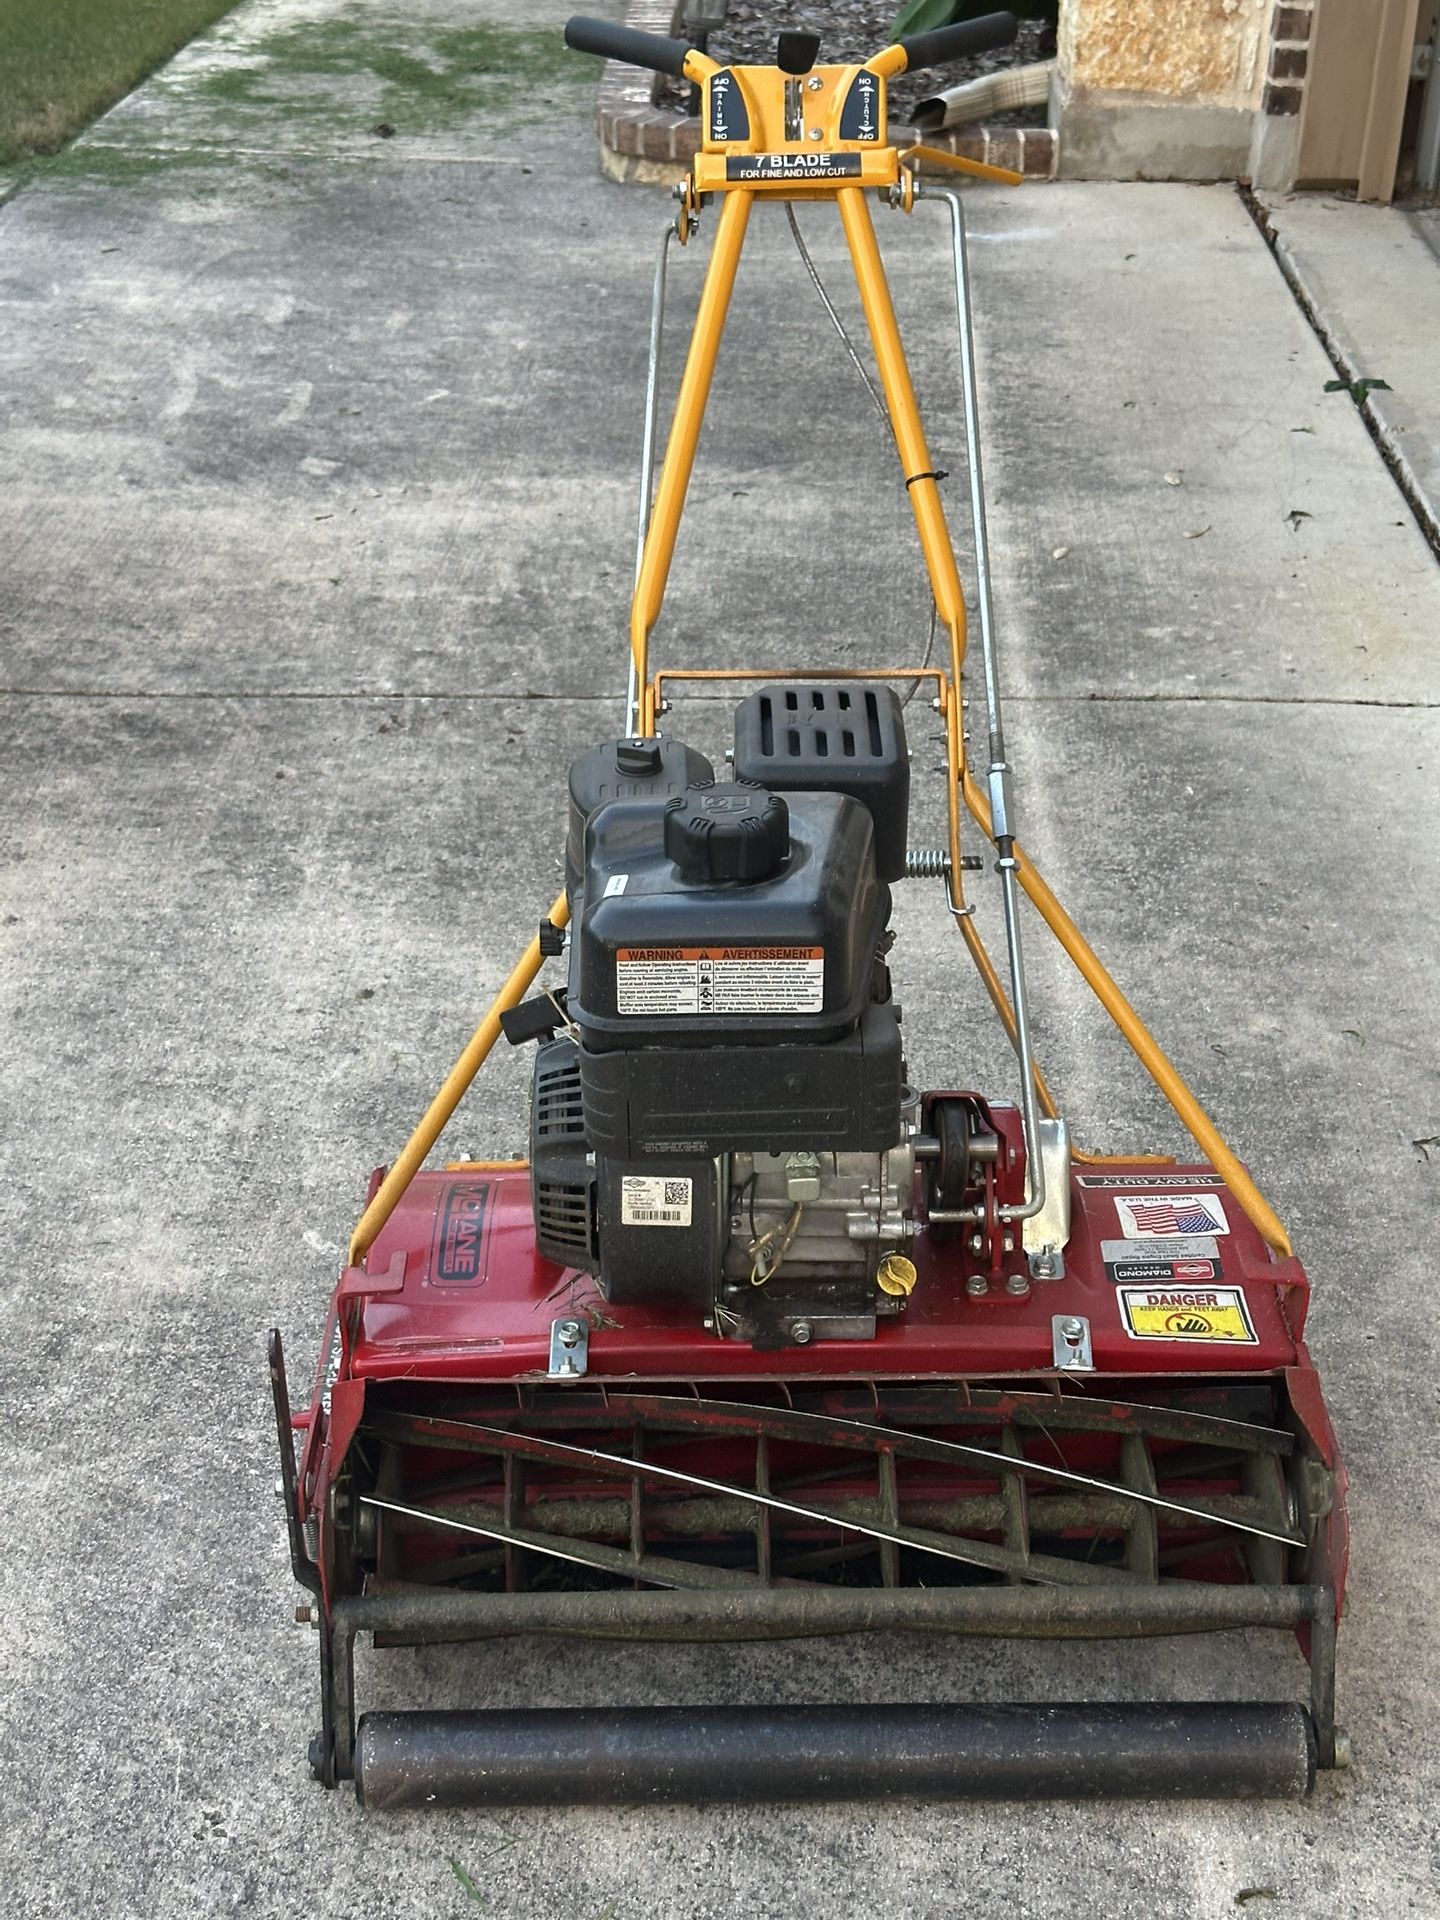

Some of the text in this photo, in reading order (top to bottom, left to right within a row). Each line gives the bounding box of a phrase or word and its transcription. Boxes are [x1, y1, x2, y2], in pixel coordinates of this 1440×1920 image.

[756, 154, 831, 167] 7 BLADE
[740, 167, 846, 178] FOR FINE AND LOW CUT
[628, 950, 683, 960] WARNING
[722, 949, 813, 959] AVERTISSEMENT
[1147, 1294, 1218, 1306] DANGER
